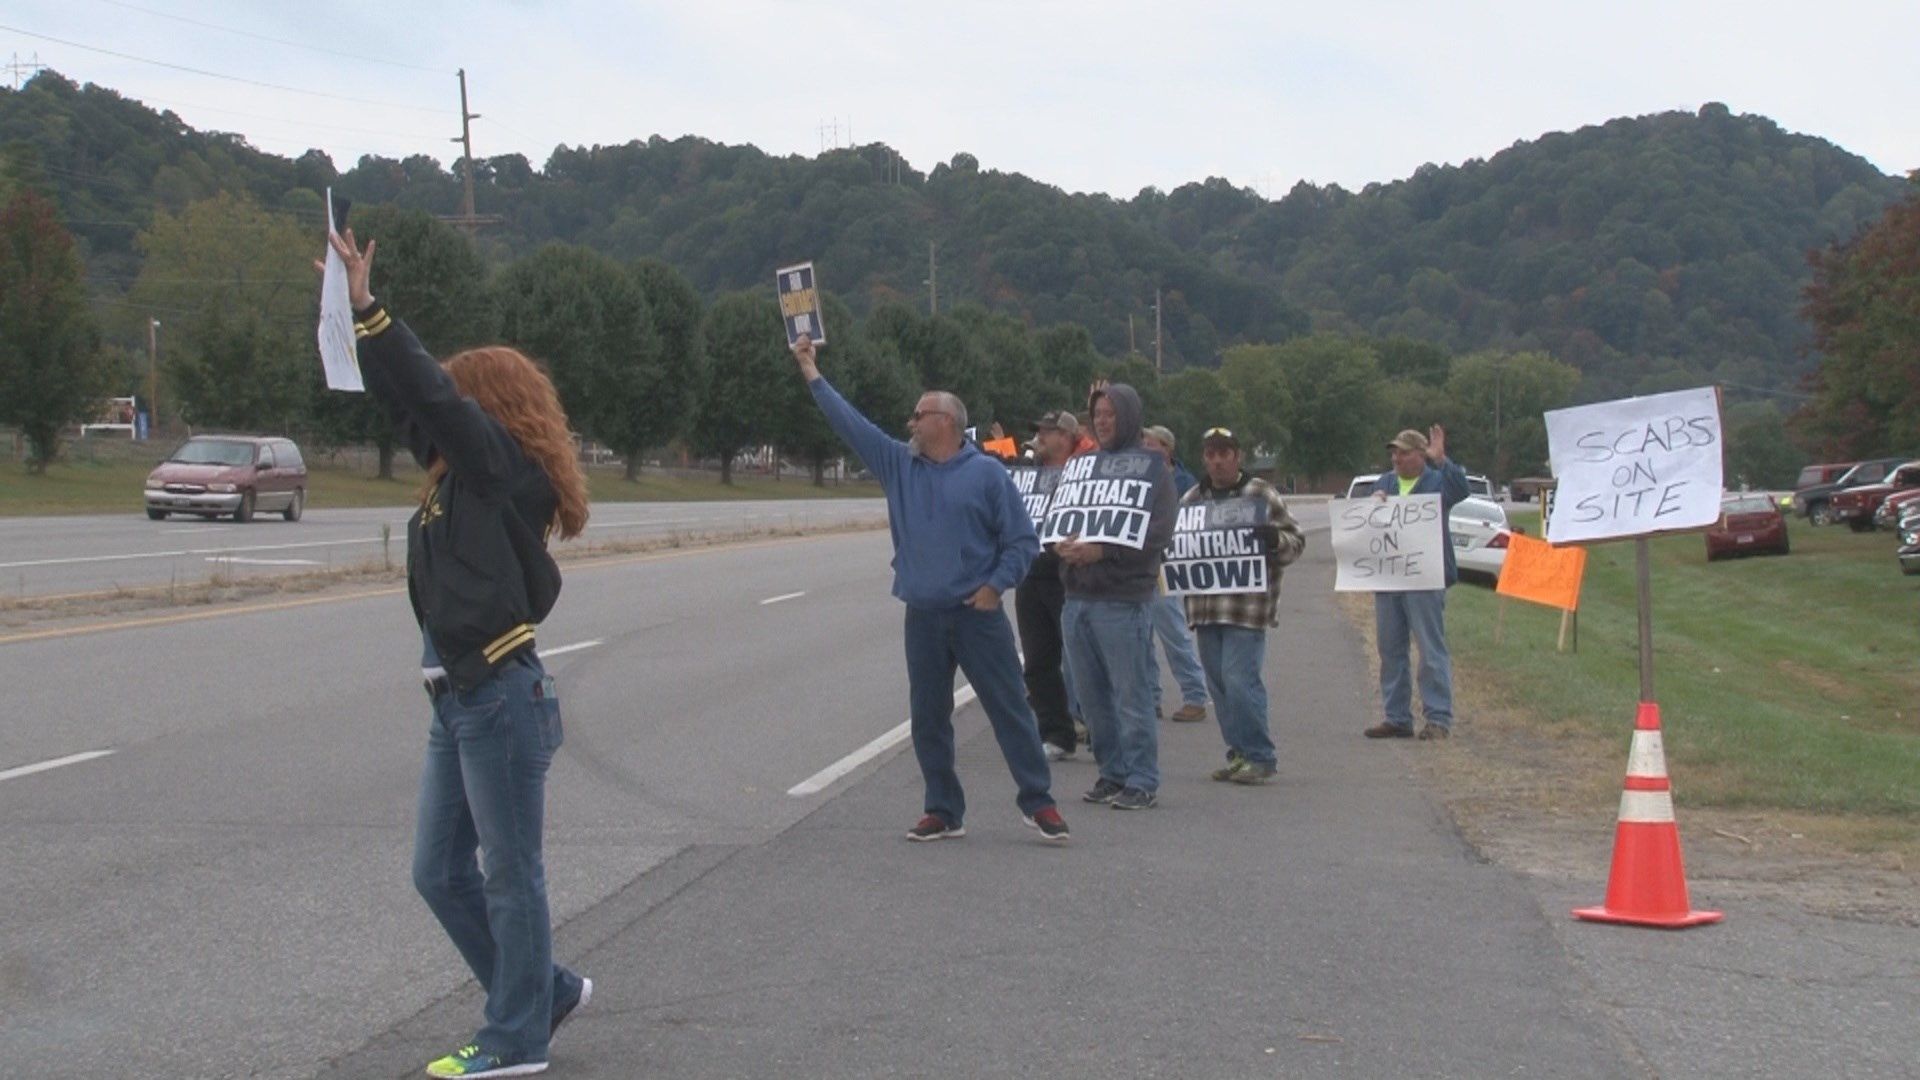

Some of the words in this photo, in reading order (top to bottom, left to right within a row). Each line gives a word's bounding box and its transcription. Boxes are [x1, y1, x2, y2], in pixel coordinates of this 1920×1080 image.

[1574, 415, 1715, 463] SCABS
[1611, 457, 1658, 489] ON
[1341, 500, 1439, 531] SCABS
[1572, 480, 1691, 523] SITE
[1369, 531, 1399, 555] ON
[1164, 559, 1263, 591] NOW!
[1353, 552, 1424, 578] SITE
